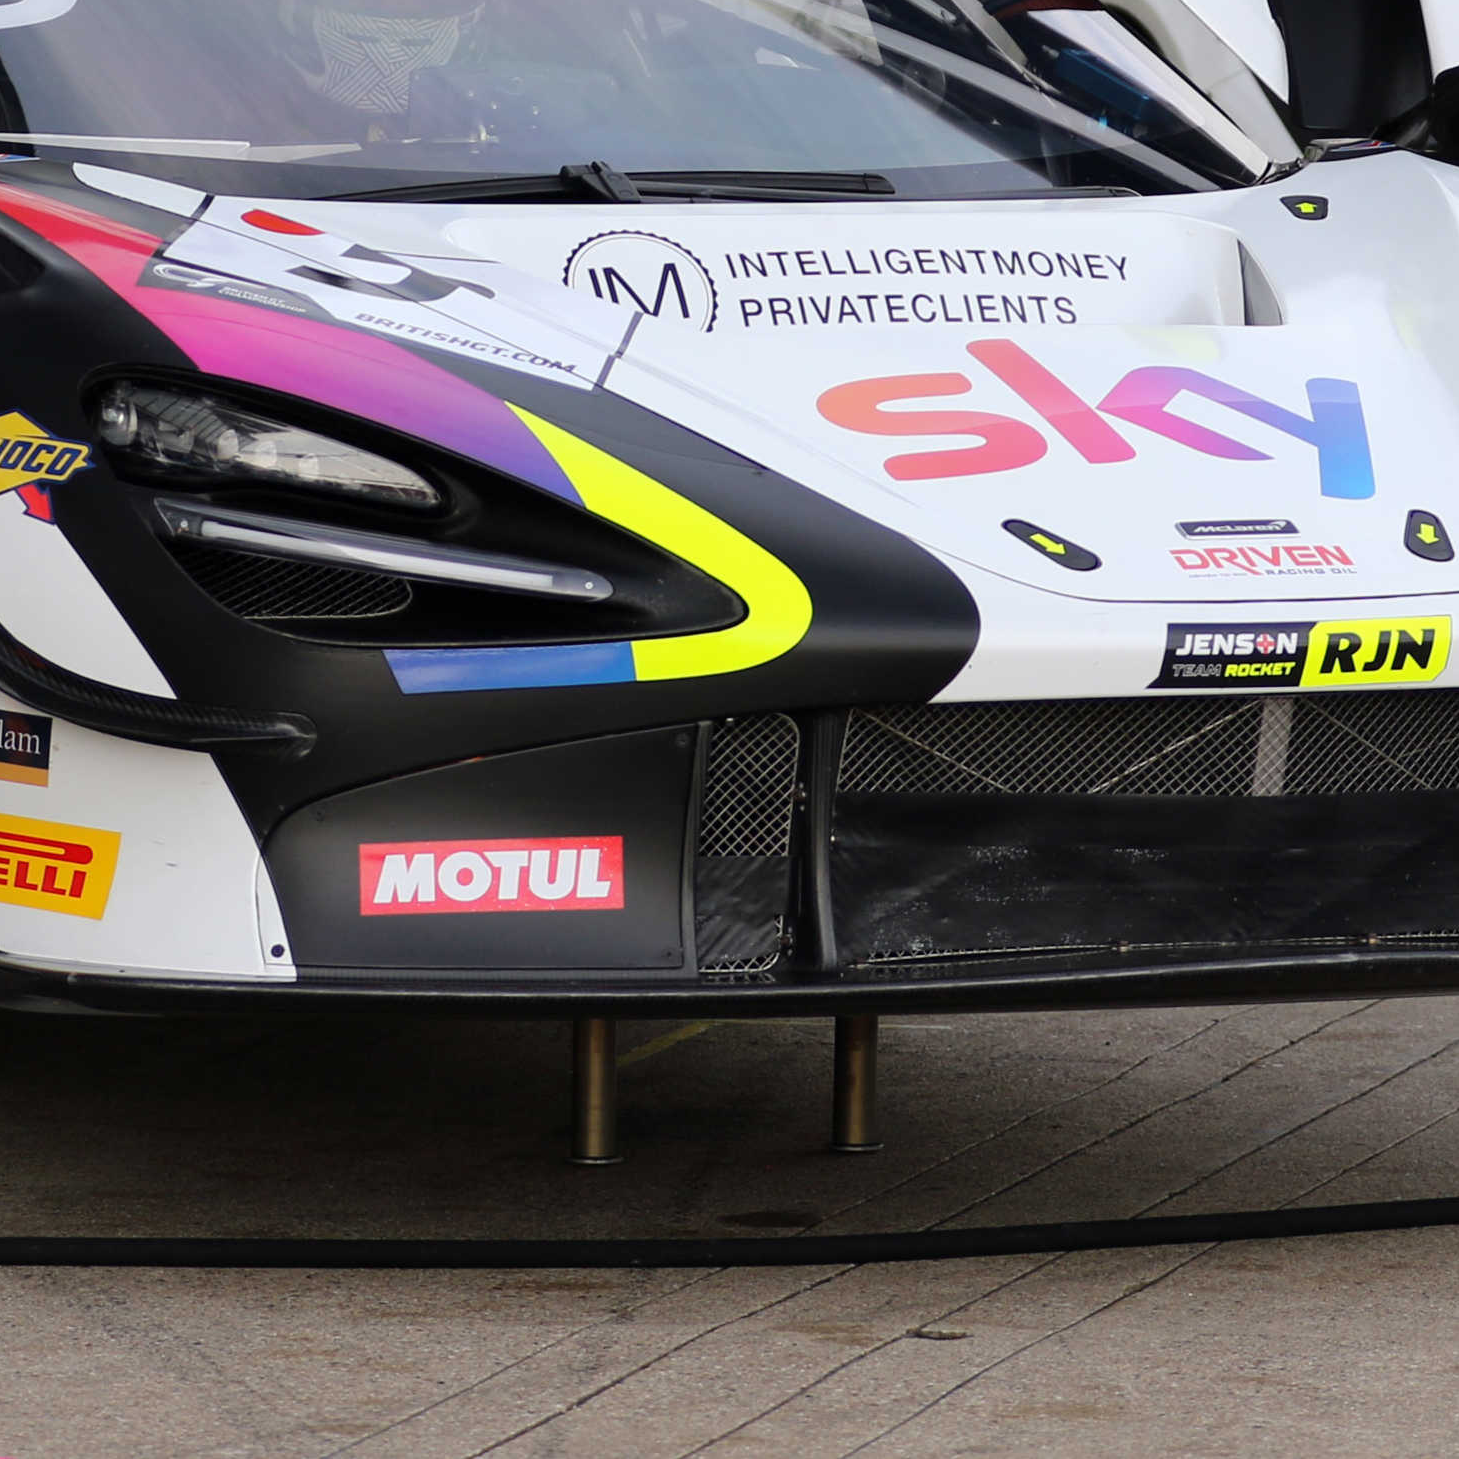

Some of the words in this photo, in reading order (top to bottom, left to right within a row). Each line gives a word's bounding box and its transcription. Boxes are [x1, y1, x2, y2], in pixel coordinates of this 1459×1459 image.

[724, 248, 1129, 282] INTELLIGENTMONEY
[739, 293, 1078, 327] PRIVATECLIENTS
[354, 311, 578, 374] BRITISHGT.COM
[816, 338, 1376, 500] sky
[1193, 522, 1285, 534] McLaren
[1169, 544, 1355, 577] DRIVEN
[1265, 568, 1326, 576] RACING
[1330, 567, 1358, 575] OIL
[1175, 631, 1299, 657] JENSON
[1319, 627, 1437, 674] RJN
[1171, 663, 1222, 678] TEAM
[1223, 660, 1297, 678] ROCKET
[372, 847, 613, 905] MOTUL
